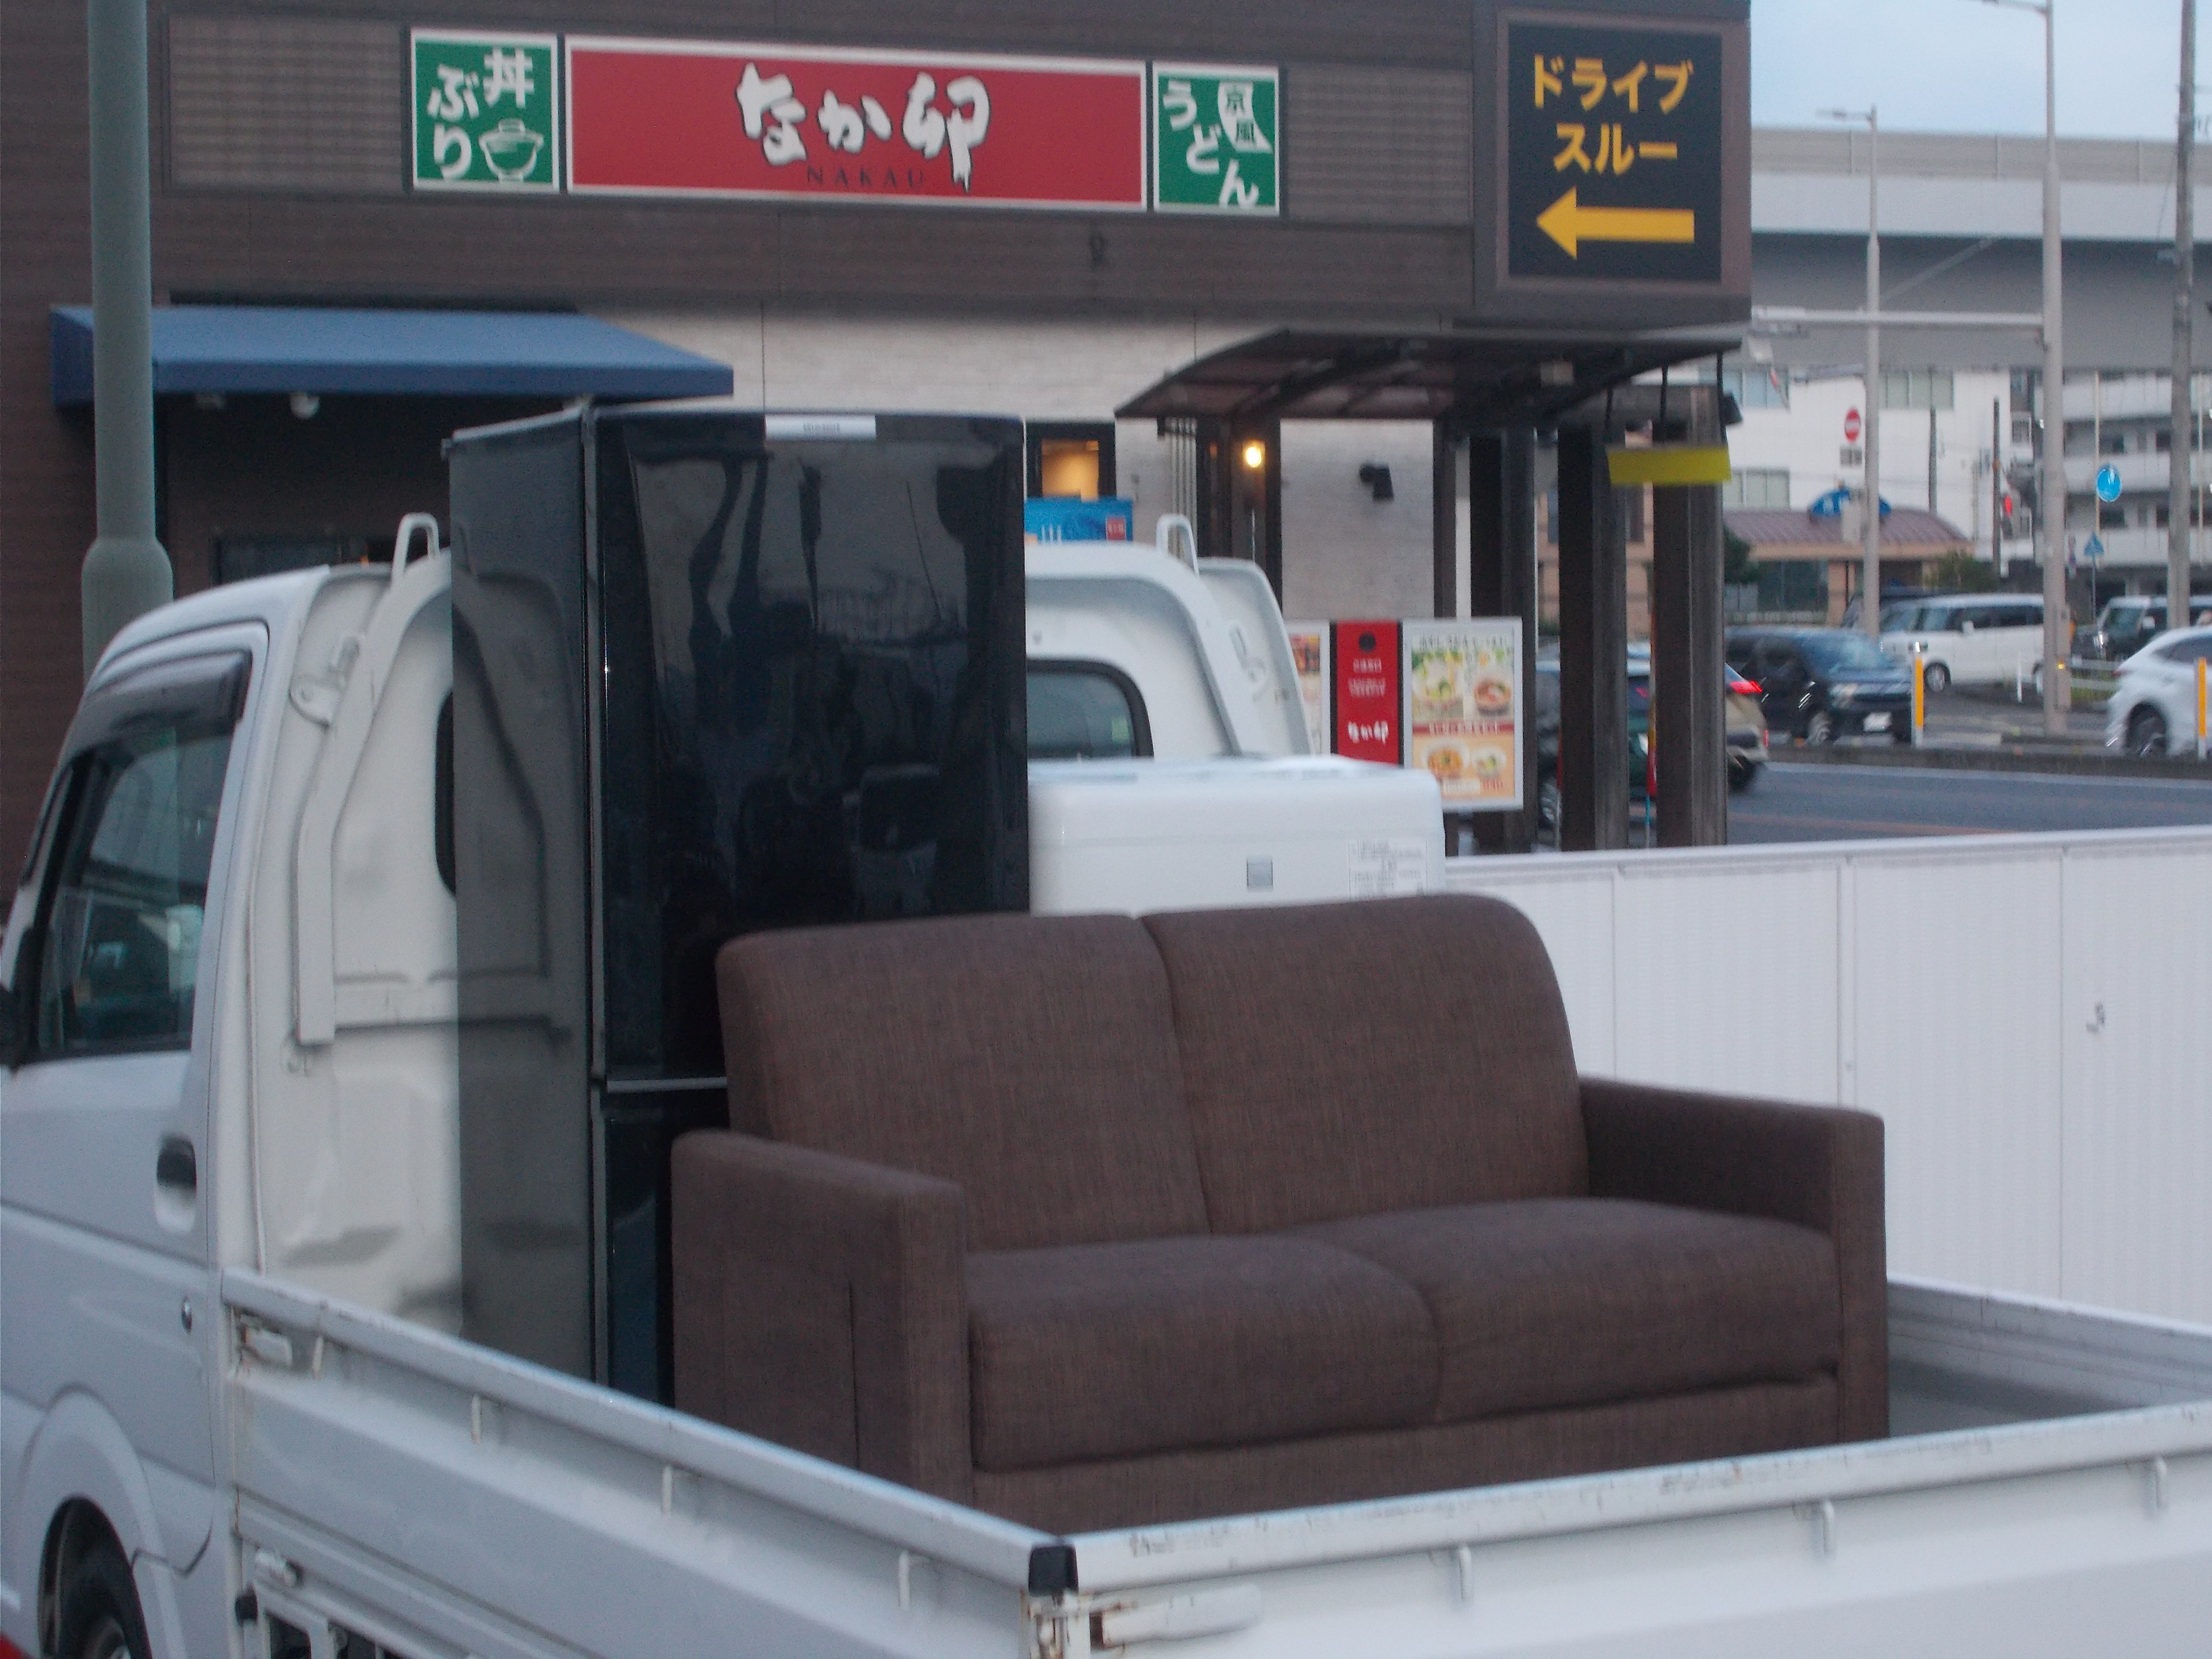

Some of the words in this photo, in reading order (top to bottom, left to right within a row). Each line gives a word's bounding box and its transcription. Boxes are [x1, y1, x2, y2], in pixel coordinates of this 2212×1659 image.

[1534, 54, 1694, 114] ドライブ
[737, 63, 990, 192] なか卯
[1163, 81, 1259, 209] うどん
[1554, 123, 1677, 174] スルー
[806, 165, 925, 189] NAKAU
